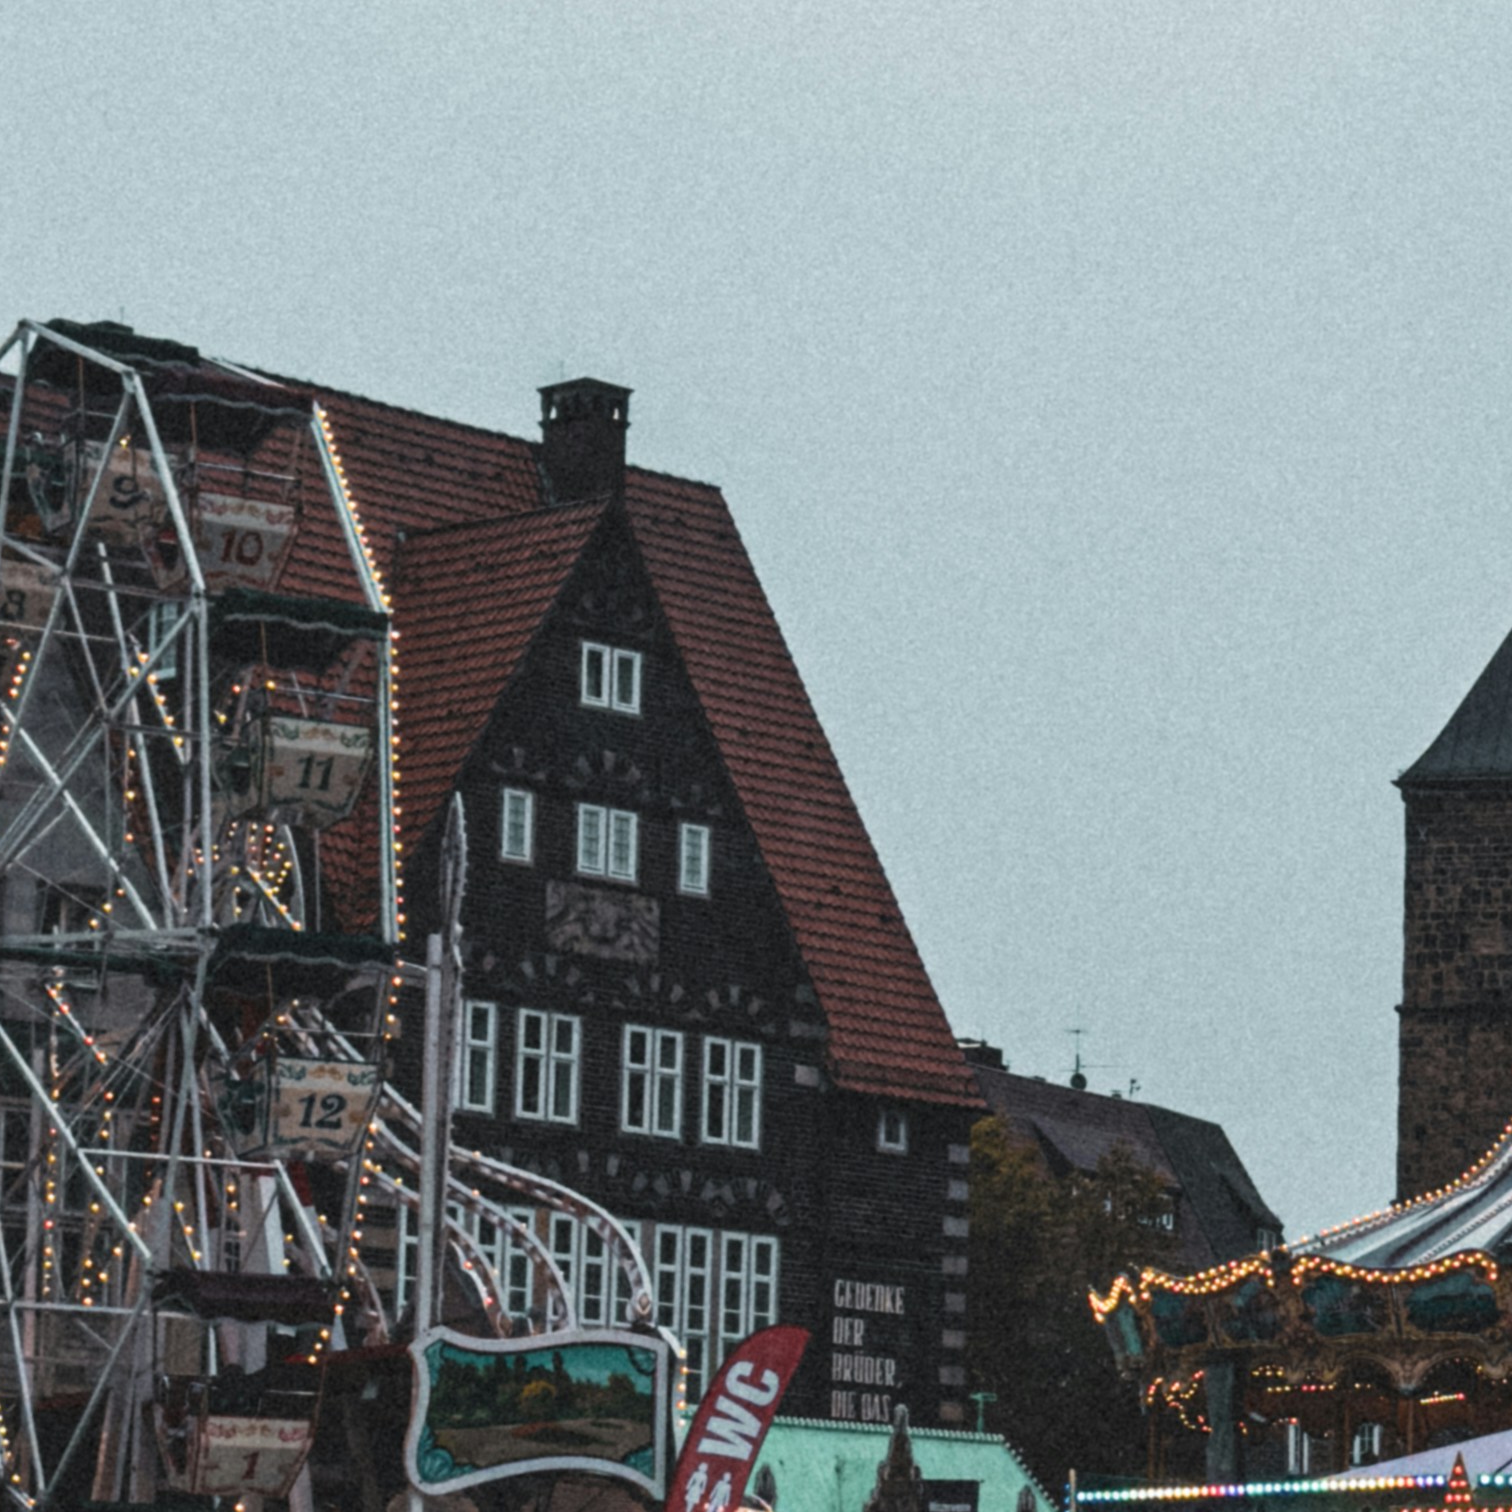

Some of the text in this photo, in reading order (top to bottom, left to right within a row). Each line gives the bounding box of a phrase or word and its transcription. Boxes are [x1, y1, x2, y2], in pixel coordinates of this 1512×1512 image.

[111, 477, 140, 508] 9
[220, 529, 263, 566] 10
[297, 755, 333, 791] 11
[296, 1092, 347, 1130] 12
[833, 1279, 906, 1315] GEDENKE
[831, 1316, 866, 1347] DER
[696, 1359, 781, 1463] WC
[242, 1449, 259, 1480] 1
